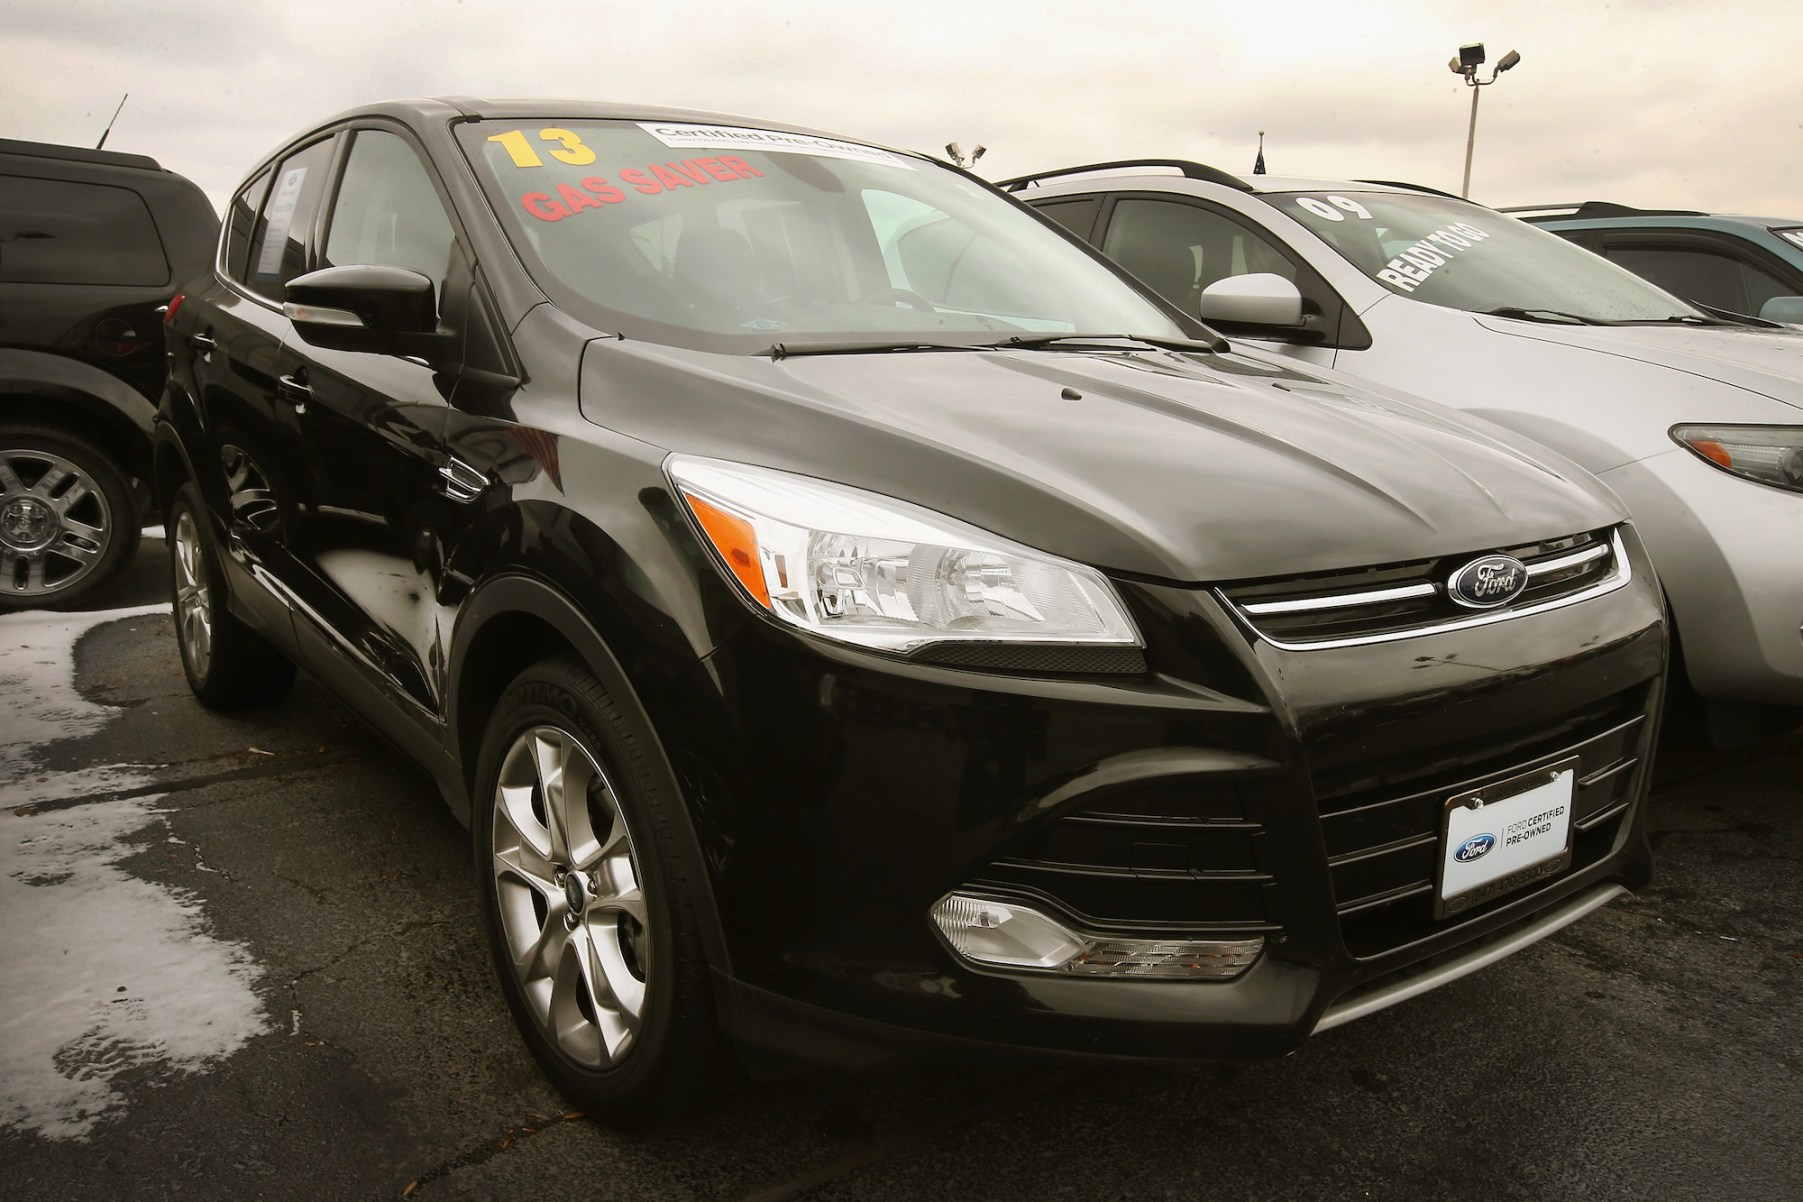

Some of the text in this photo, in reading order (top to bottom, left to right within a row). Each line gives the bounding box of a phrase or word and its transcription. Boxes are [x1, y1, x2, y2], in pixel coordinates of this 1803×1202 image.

[487, 127, 597, 168] 13
[655, 127, 765, 141] Certified
[765, 134, 892, 159] Pre-Owned
[520, 154, 765, 222] GAS SAVER
[1296, 195, 1373, 222] 09
[1376, 222, 1490, 293] READY TO GO
[1473, 562, 1518, 598] Ford
[1505, 822, 1552, 847] PRE-OWNED
[1507, 805, 1565, 835] FORD CERTIFIED
[1461, 837, 1490, 860] Ford
